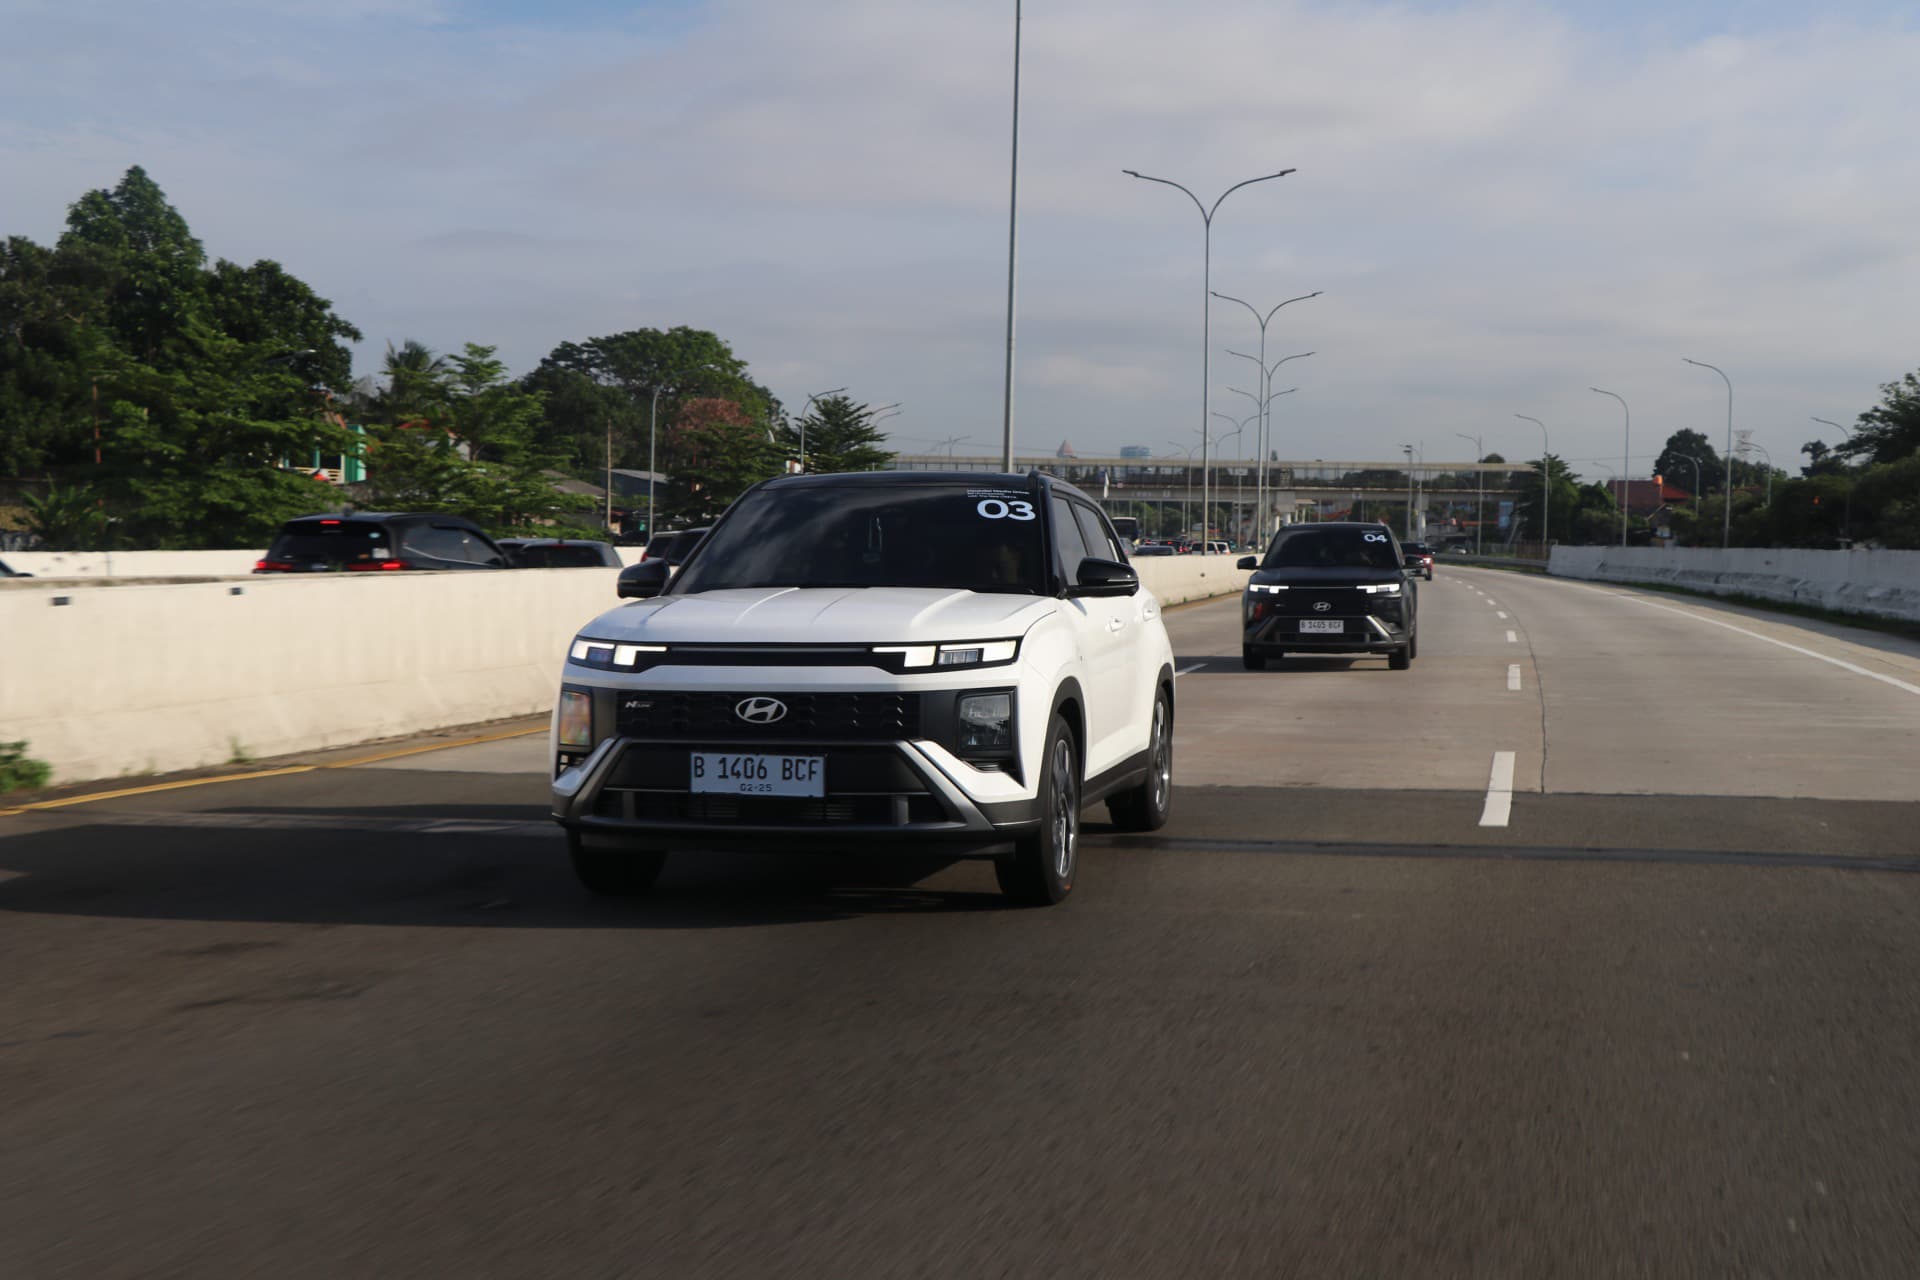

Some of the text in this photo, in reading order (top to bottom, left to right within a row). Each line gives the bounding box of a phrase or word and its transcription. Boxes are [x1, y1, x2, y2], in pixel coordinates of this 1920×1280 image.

[977, 499, 1036, 520] 03
[1364, 534, 1387, 542] 04
[693, 756, 820, 781] B 1406 BCF
